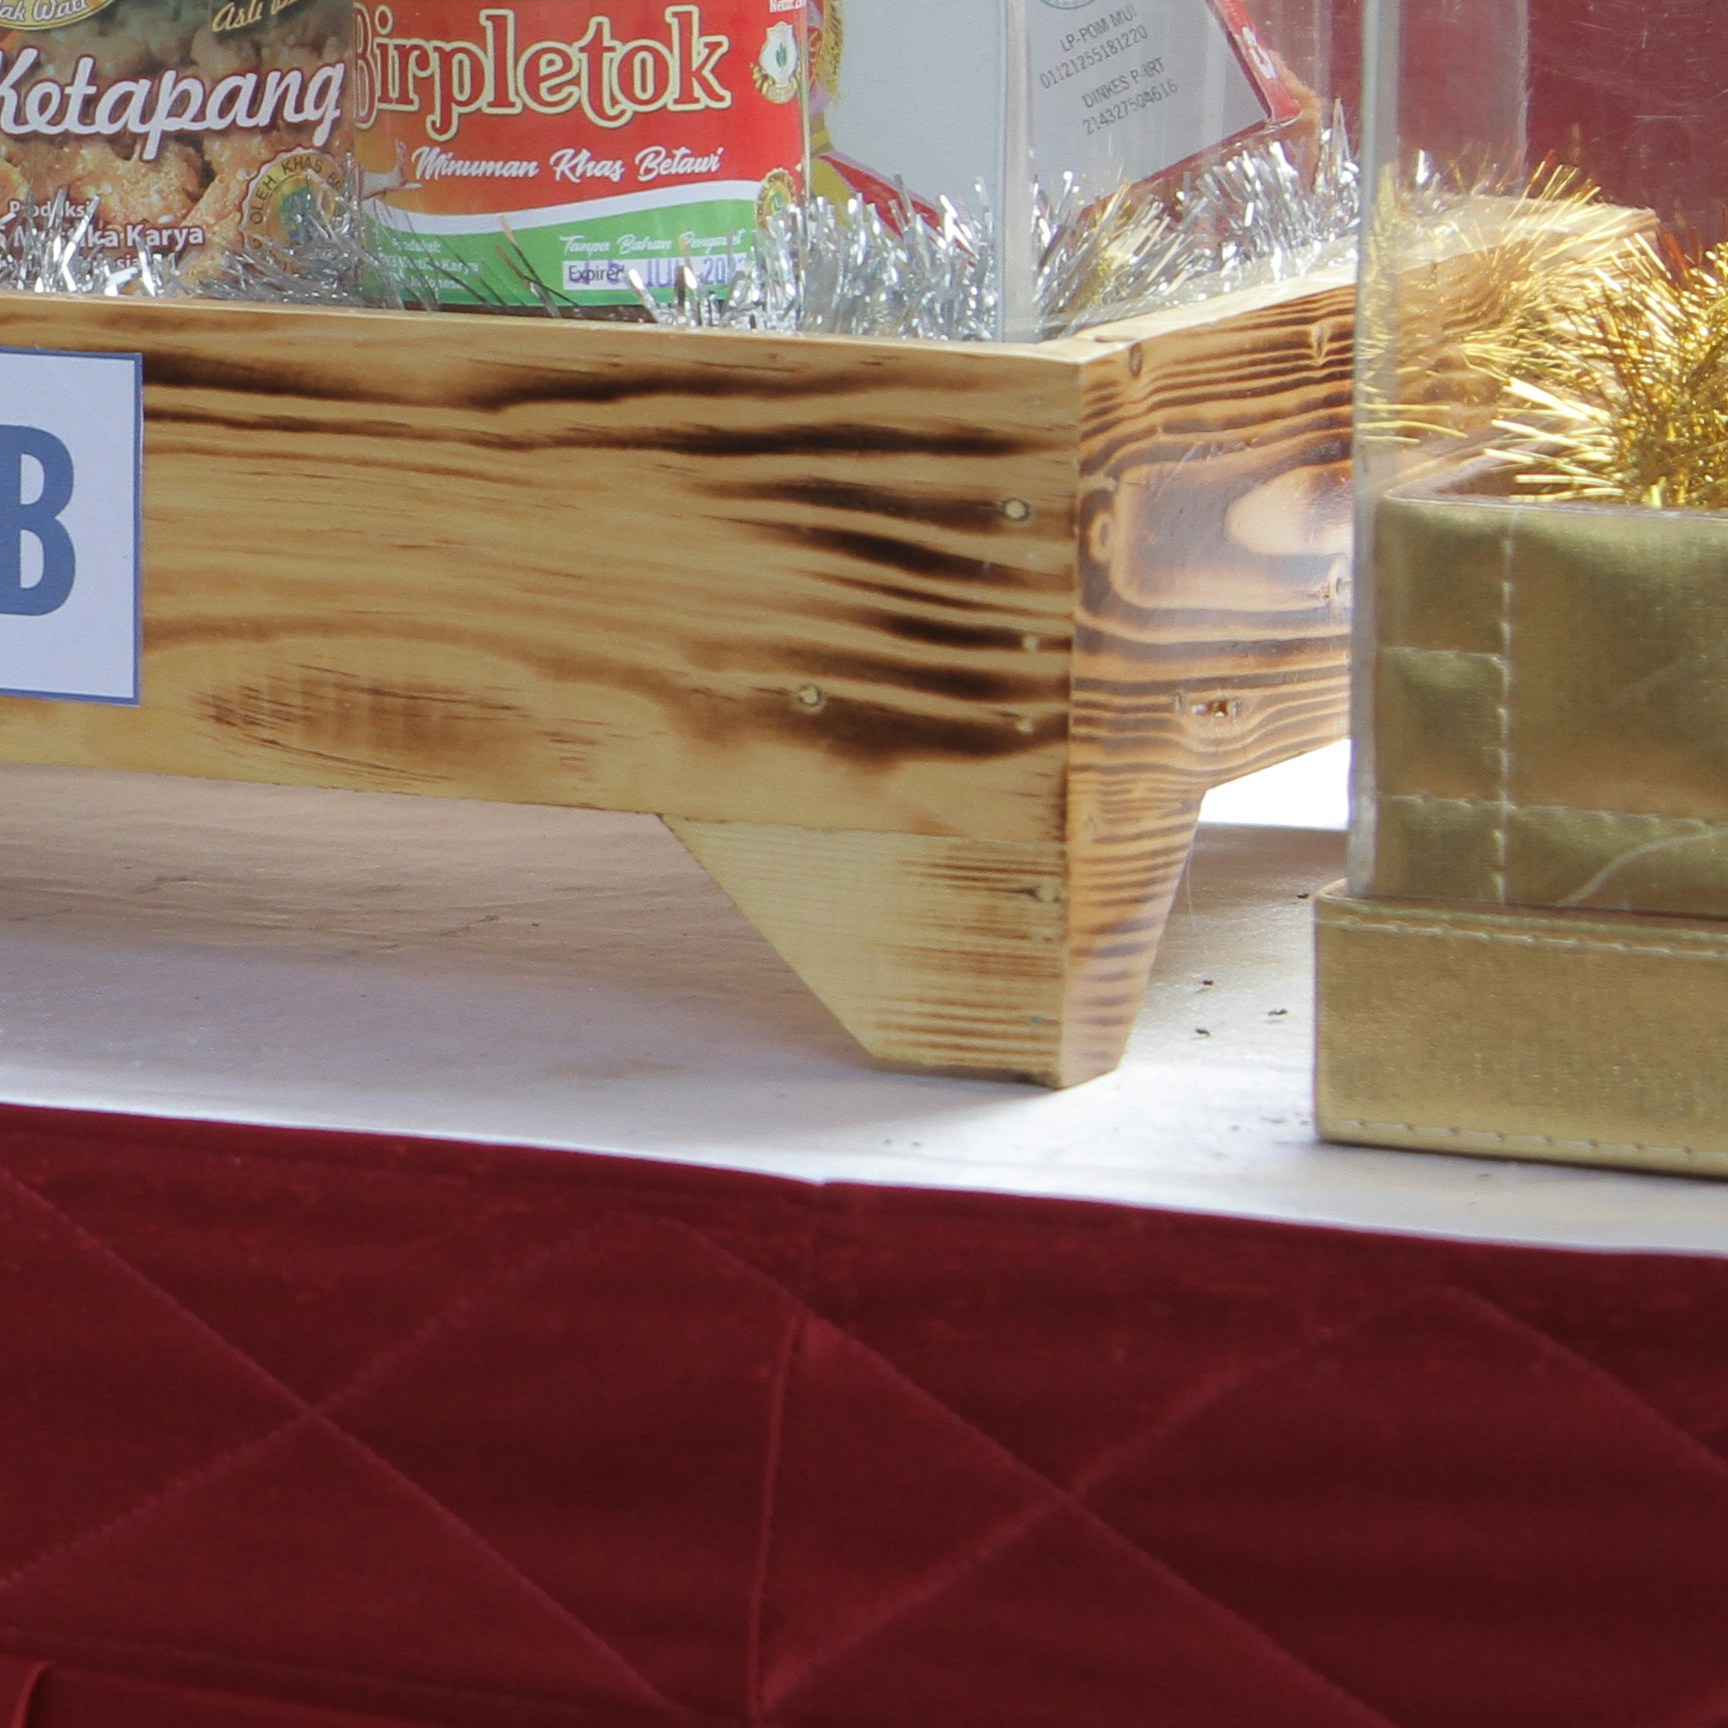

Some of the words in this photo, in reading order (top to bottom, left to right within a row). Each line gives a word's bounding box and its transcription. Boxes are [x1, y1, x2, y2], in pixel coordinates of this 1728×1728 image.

[210, 0, 264, 34] Asli
[1059, 17, 1109, 53] LP-POM
[1110, 3, 1137, 33] MUI
[353, 0, 733, 144] Birpletok
[1081, 75, 1132, 110] DINKES
[411, 144, 540, 181] Minuman
[549, 147, 627, 183] Khas
[635, 146, 725, 183] Betawi
[250, 174, 277, 225] OLEH
[280, 156, 324, 176] KHAS
[124, 220, 205, 258] Karya
[617, 233, 673, 255] Bahan
[567, 262, 626, 283] Expire
